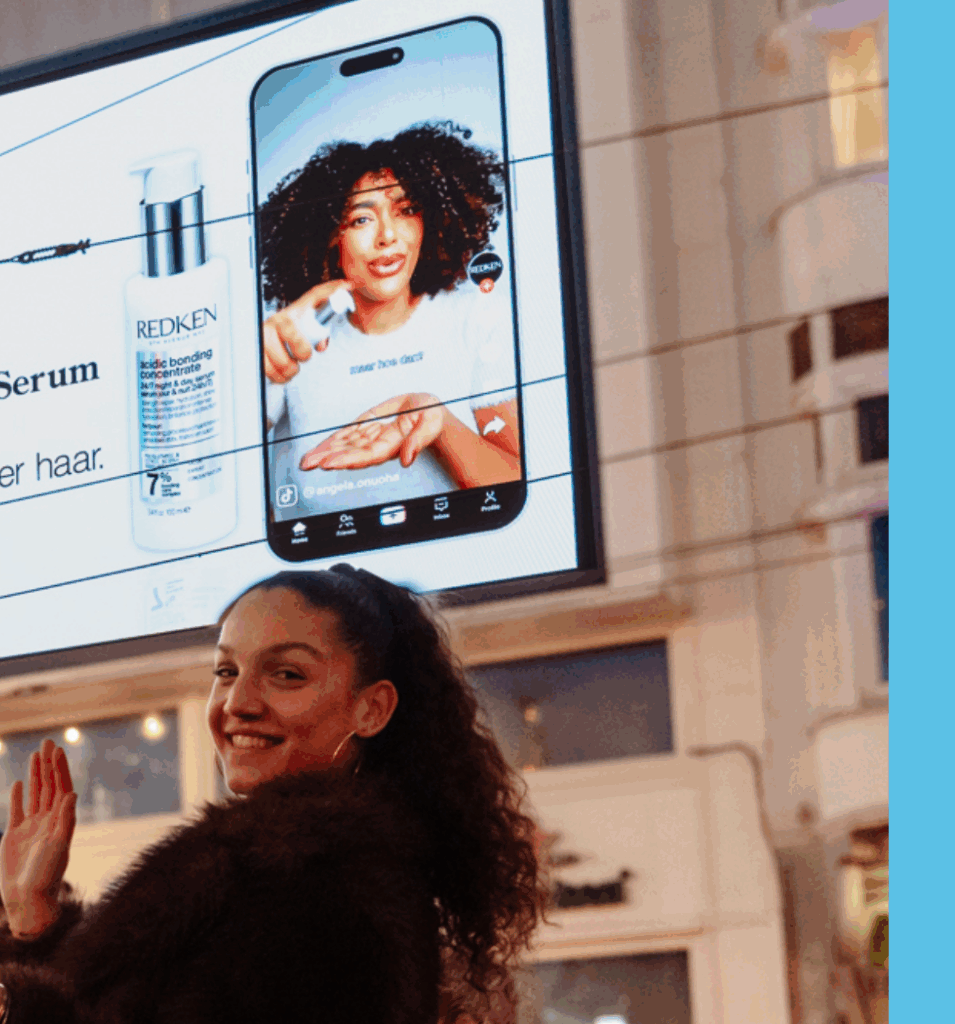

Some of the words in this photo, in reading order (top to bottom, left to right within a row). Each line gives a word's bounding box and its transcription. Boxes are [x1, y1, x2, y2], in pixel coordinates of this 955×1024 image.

[137, 303, 217, 339] REDKEN
[169, 348, 213, 367] bonding
[140, 363, 201, 379] concentrate
[37, 447, 104, 481] haar.
